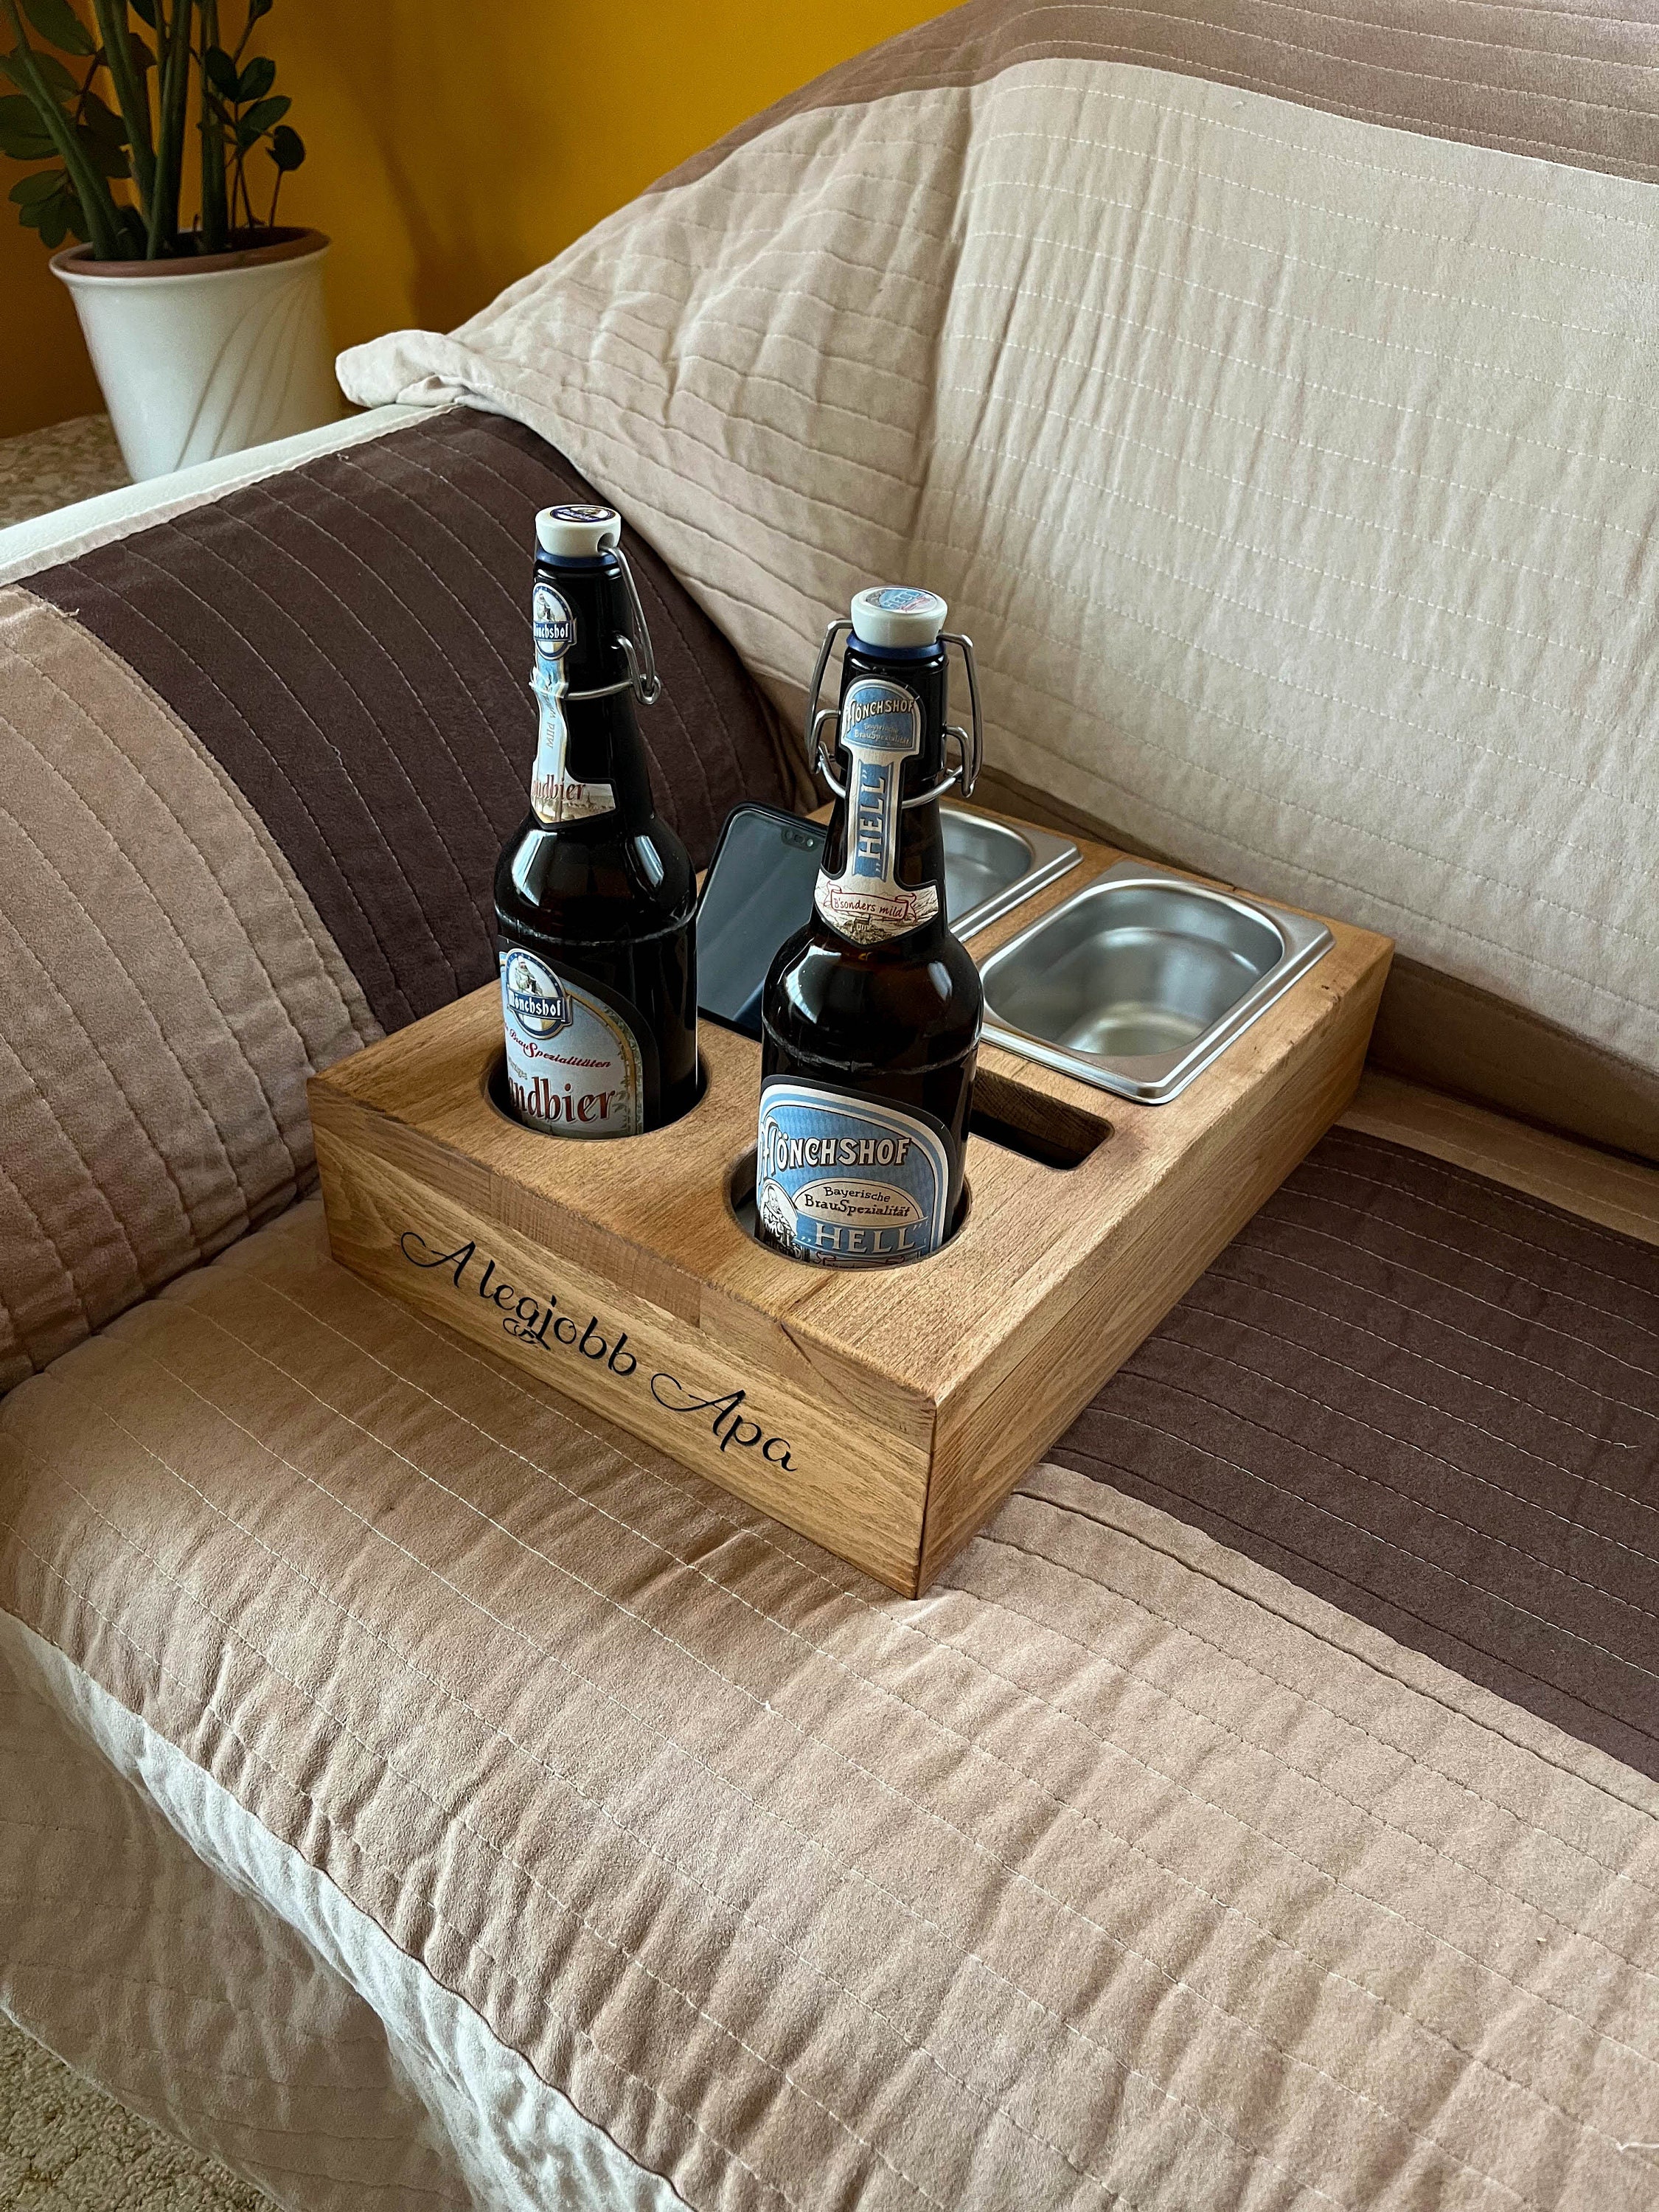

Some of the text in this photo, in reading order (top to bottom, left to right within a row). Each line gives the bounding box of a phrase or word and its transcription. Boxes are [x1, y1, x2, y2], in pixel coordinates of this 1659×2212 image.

[879, 905, 903, 918] mild
[823, 1186, 891, 1203] Bayerische
[804, 1194, 912, 1217] BrauSpezialität
[400, 1231, 798, 1472] Alegjobb Apa
